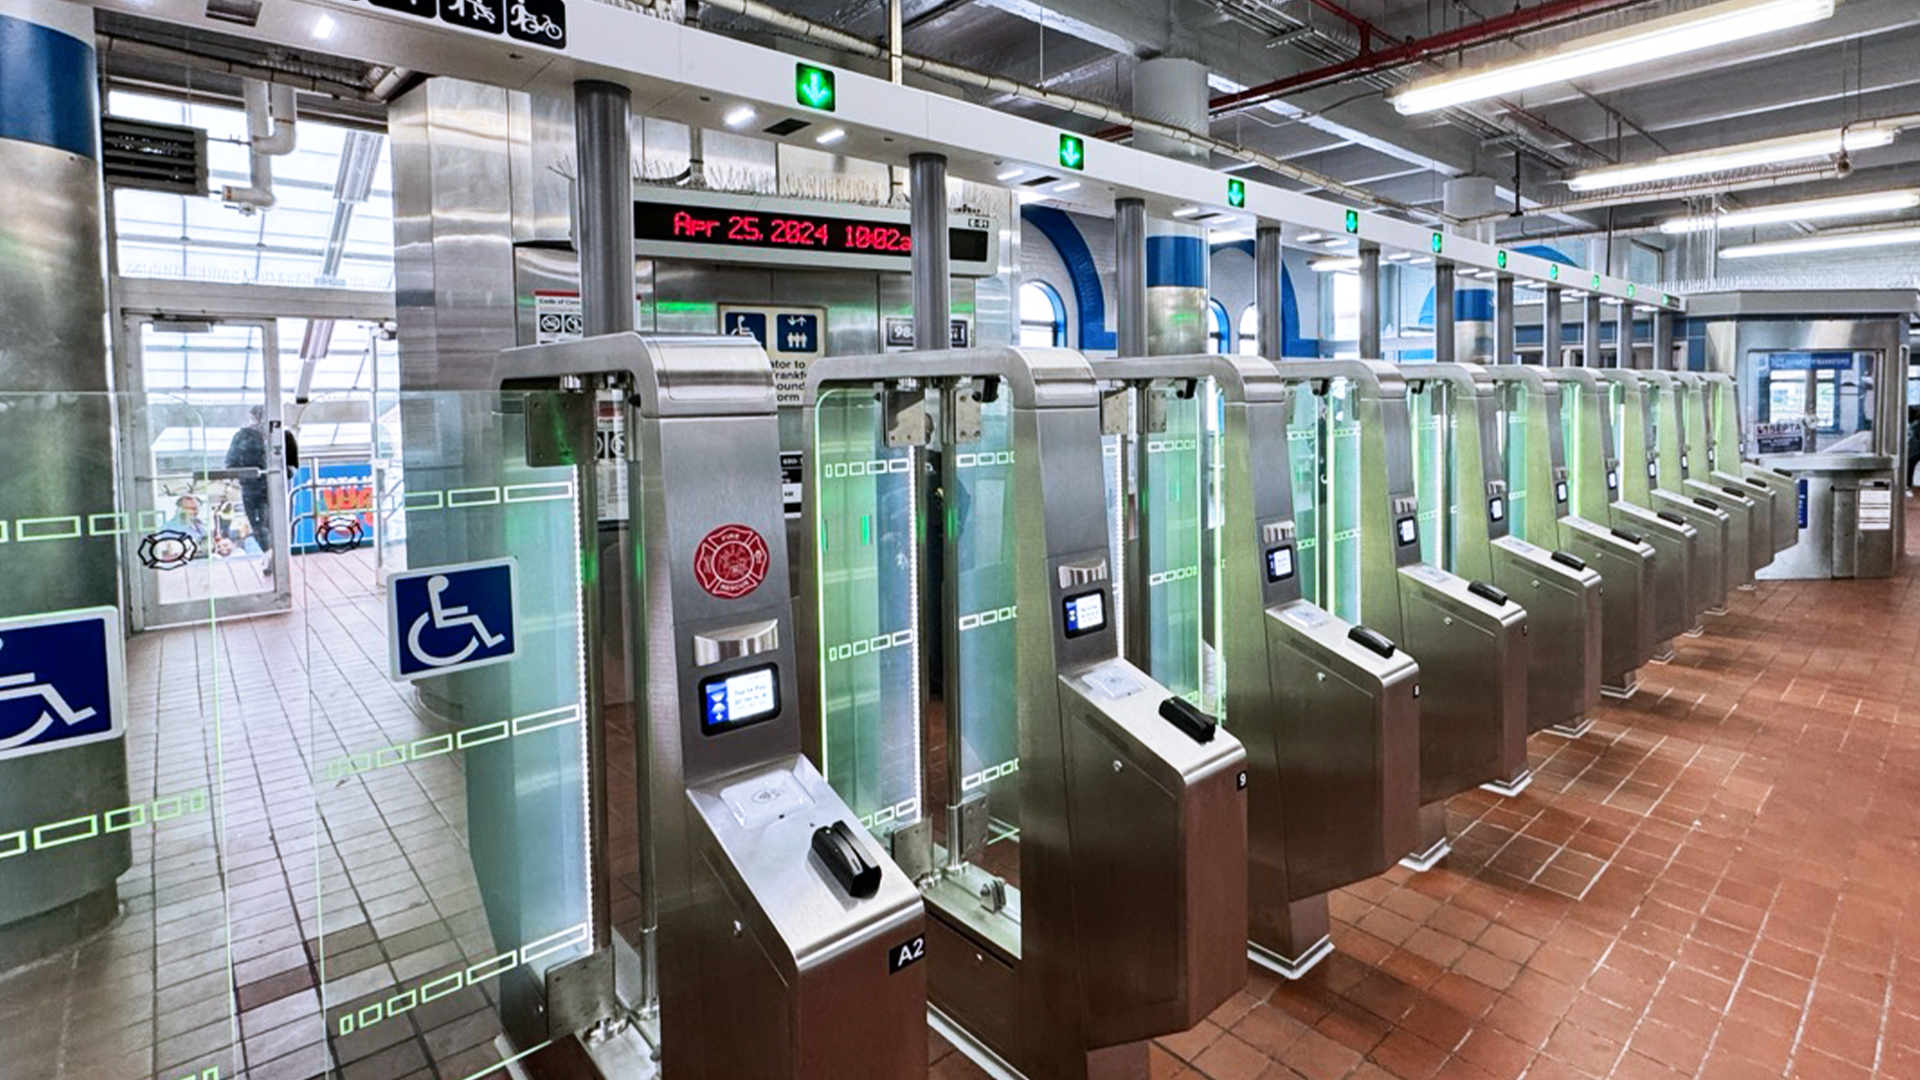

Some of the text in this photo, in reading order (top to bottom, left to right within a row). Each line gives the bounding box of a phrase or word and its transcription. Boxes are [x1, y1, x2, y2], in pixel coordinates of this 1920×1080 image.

[673, 211, 721, 237] Apr
[770, 219, 828, 245] 2024
[794, 360, 806, 369] to
[1239, 772, 1247, 786] 9
[897, 937, 924, 967] A2
